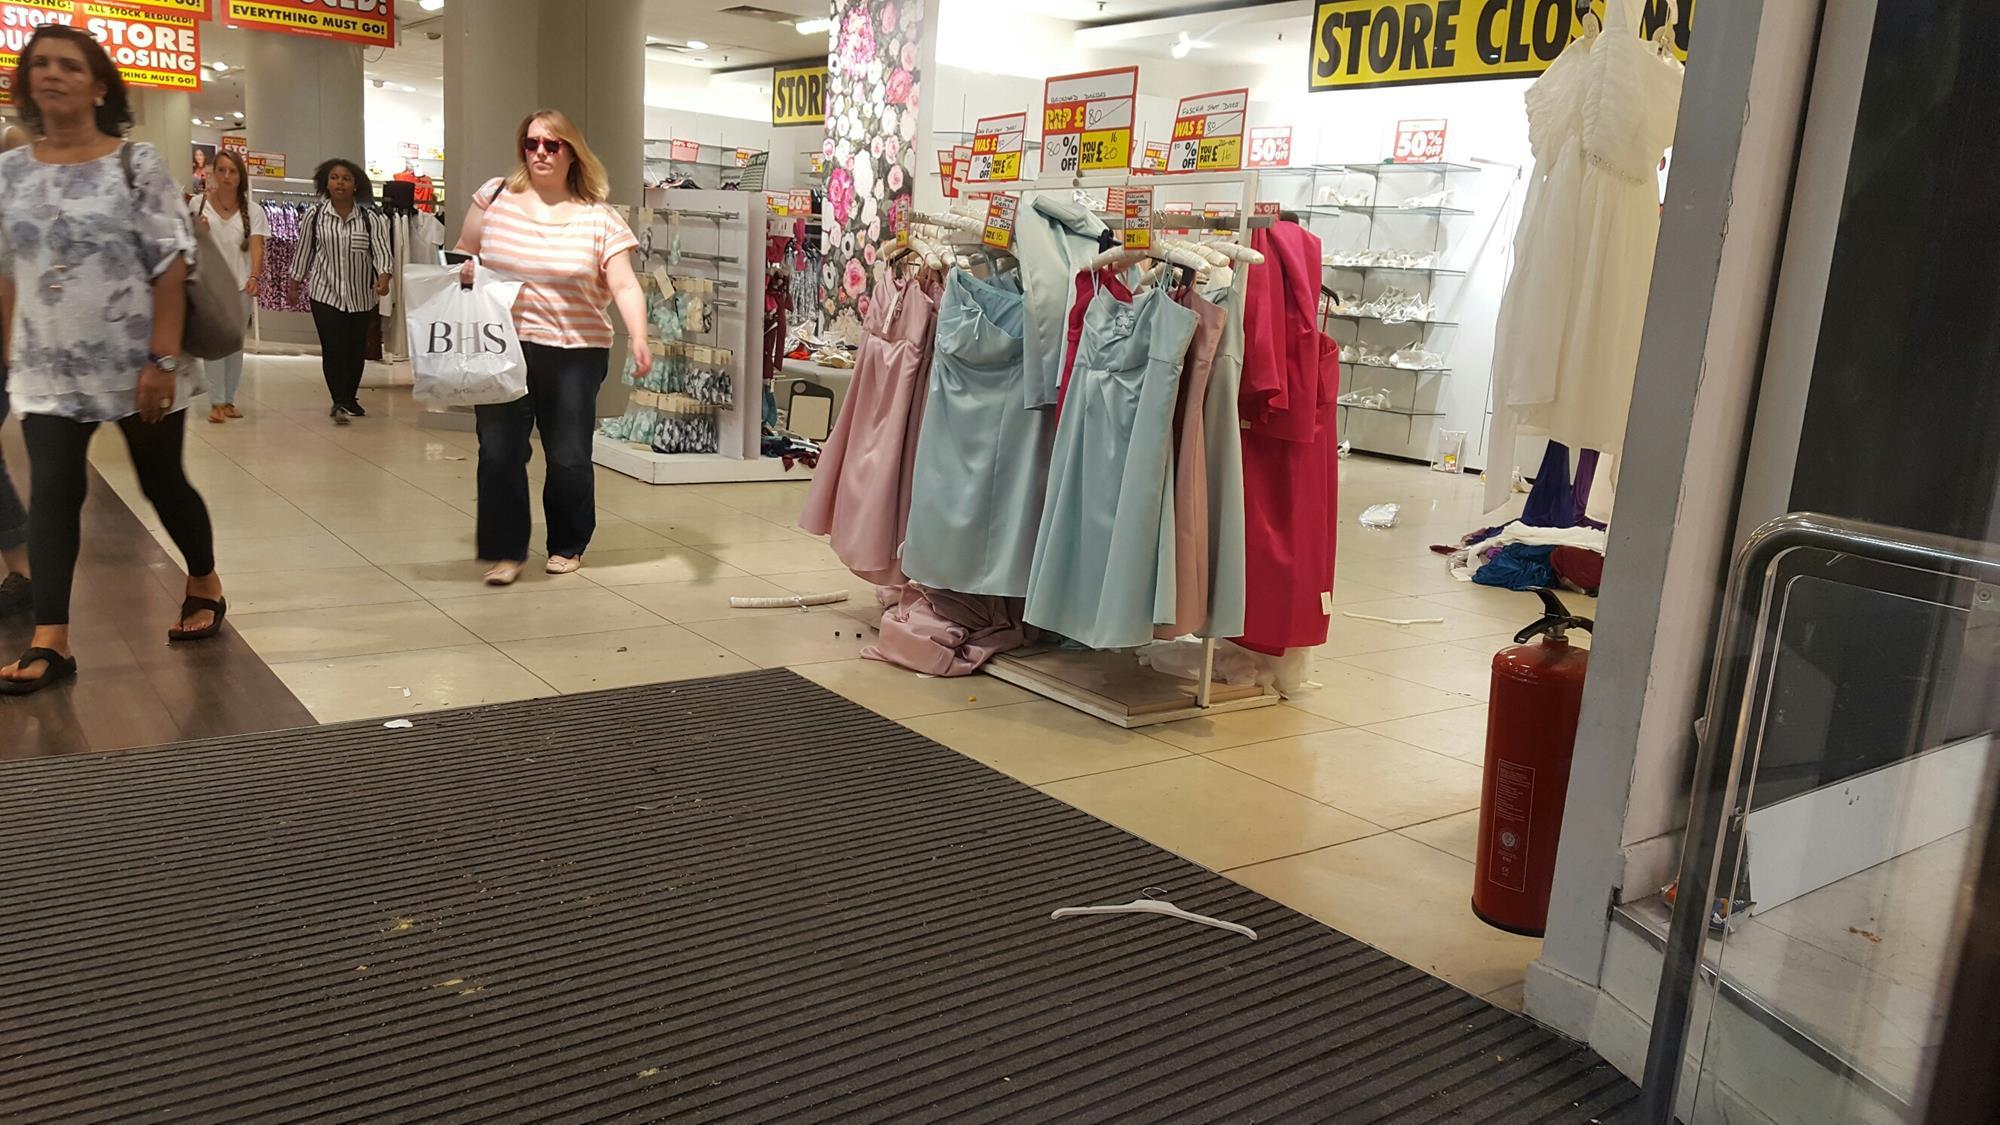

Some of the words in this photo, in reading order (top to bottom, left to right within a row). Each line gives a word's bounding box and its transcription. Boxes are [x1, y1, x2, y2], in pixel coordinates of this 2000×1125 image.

[88, 5, 106, 13] ALL
[109, 8, 142, 17] STOCK
[144, 11, 193, 24] REDUCED!
[233, 5, 318, 25] EVERYTHING
[323, 17, 358, 30] MUST
[362, 23, 385, 35] GO!
[87, 17, 195, 52] STORE
[1316, 1, 1460, 78] STORE
[104, 46, 196, 71] LOSING
[1075, 106, 1085, 128] £
[1088, 109, 1103, 125] 80
[1175, 121, 1195, 137] WAS
[975, 138, 990, 152] WAS
[1063, 135, 1078, 156] %
[1081, 154, 1095, 163] PAY
[1096, 141, 1104, 162] £
[1082, 142, 1097, 152] YOU
[1185, 141, 1197, 157] %
[1200, 146, 1212, 154] YOU
[1250, 139, 1276, 161] 50
[1396, 131, 1428, 157] 50
[1425, 145, 1442, 156] OFF
[1182, 158, 1196, 169] OFF
[1199, 155, 1211, 163] PAY
[1275, 151, 1288, 160] OFF
[1061, 158, 1077, 171] OFF
[980, 169, 991, 179] OFF
[1264, 204, 1279, 213] OFF
[426, 320, 507, 355] BHS
